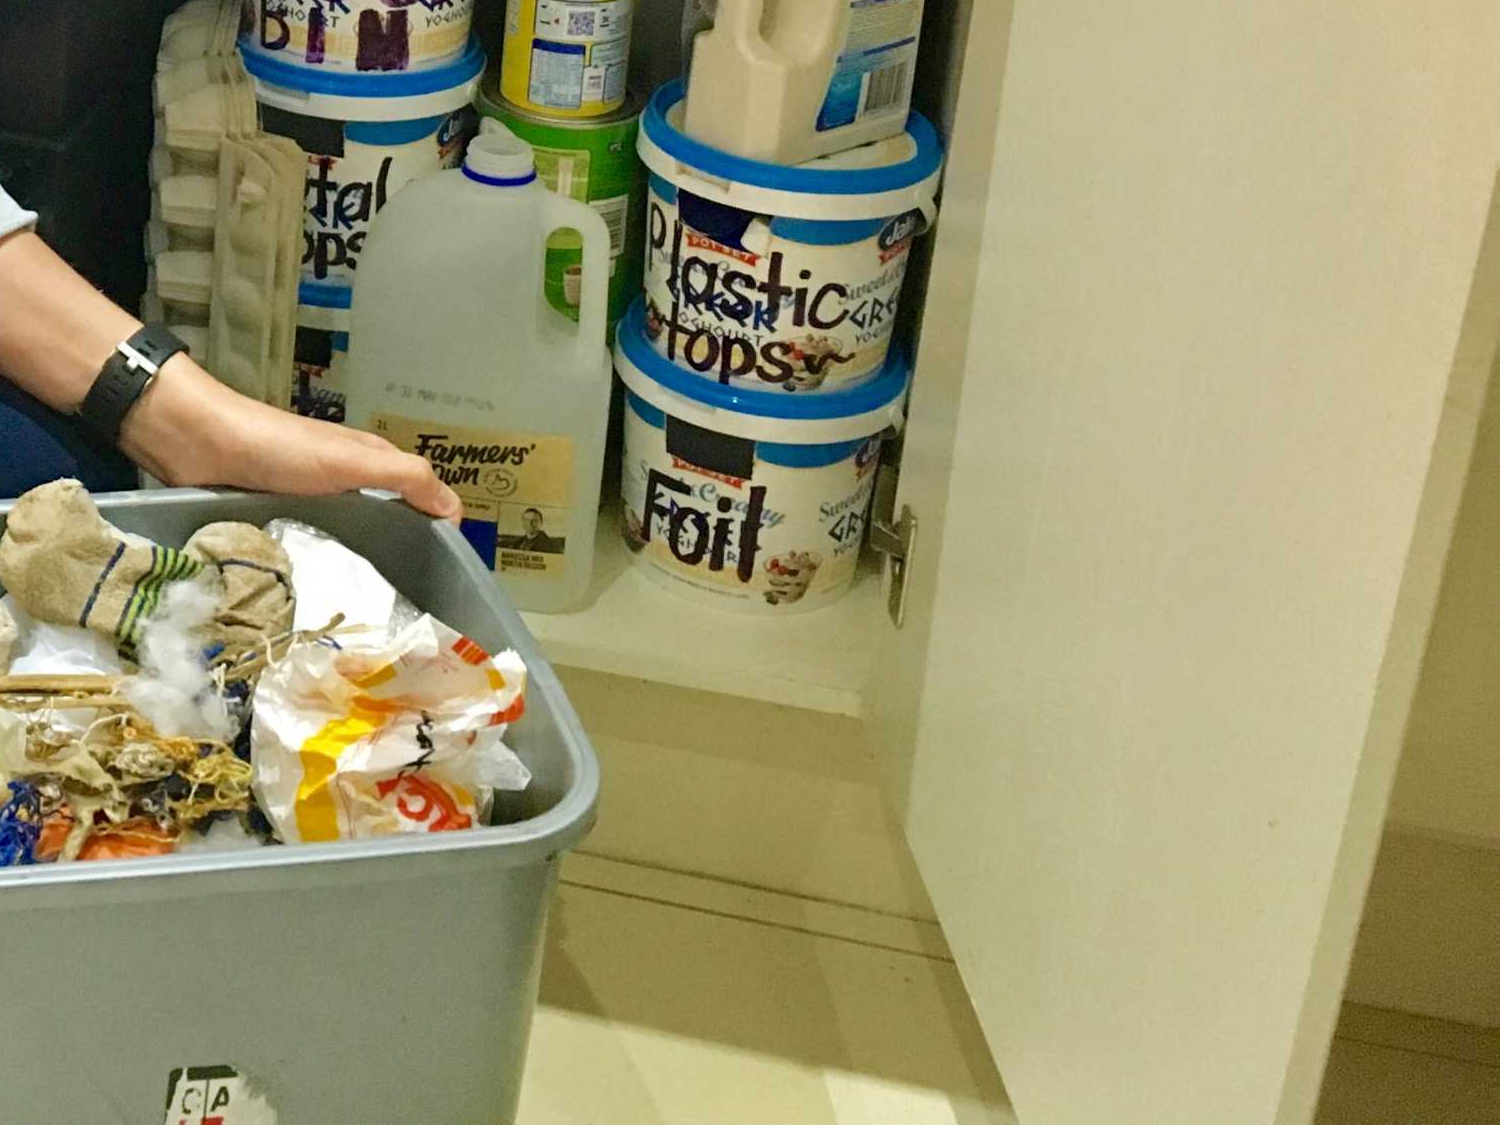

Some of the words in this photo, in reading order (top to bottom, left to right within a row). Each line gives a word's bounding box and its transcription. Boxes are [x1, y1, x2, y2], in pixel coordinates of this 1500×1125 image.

[303, 156, 393, 222] tal
[648, 201, 850, 329] Plastic
[414, 433, 536, 467] Farmers'
[641, 468, 768, 583] Foil
